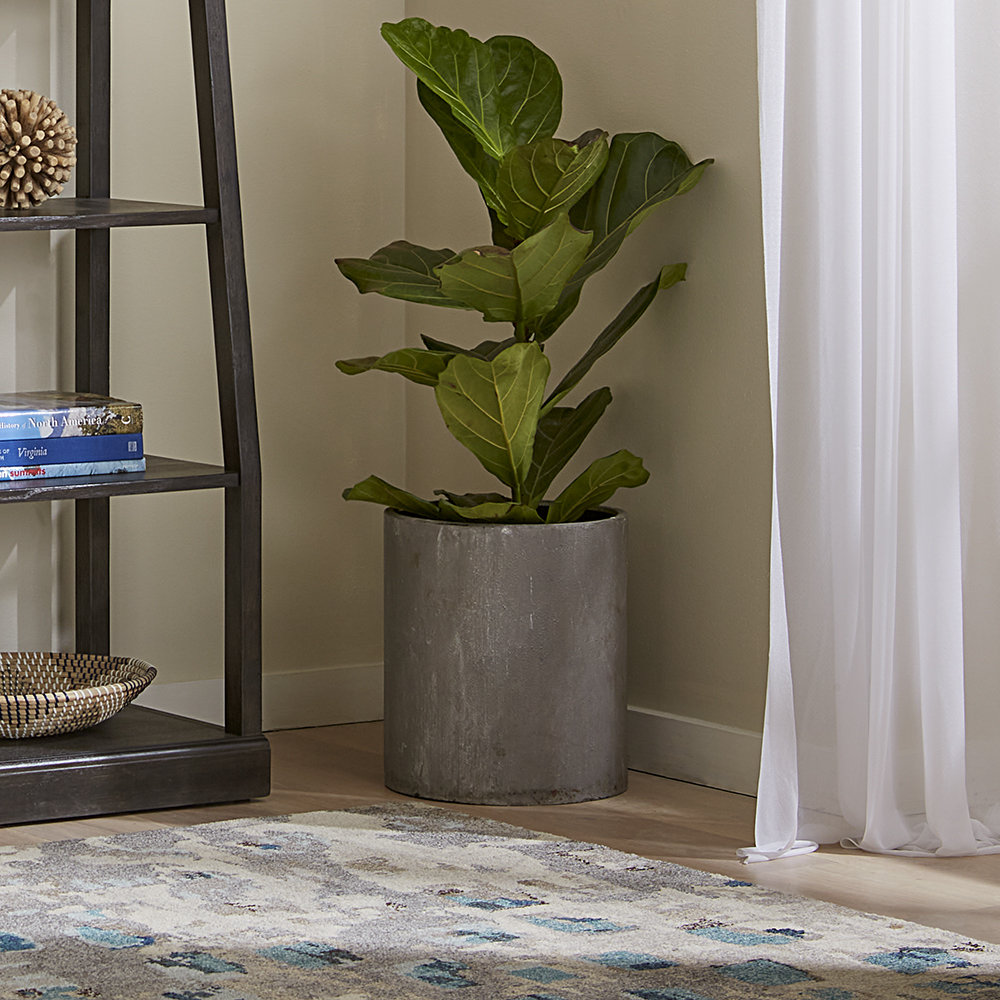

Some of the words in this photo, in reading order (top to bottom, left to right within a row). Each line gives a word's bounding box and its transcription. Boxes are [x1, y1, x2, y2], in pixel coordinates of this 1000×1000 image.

[0, 422, 20, 430] History
[28, 416, 58, 429] North
[60, 414, 103, 427] America
[17, 446, 48, 460] Virginia
